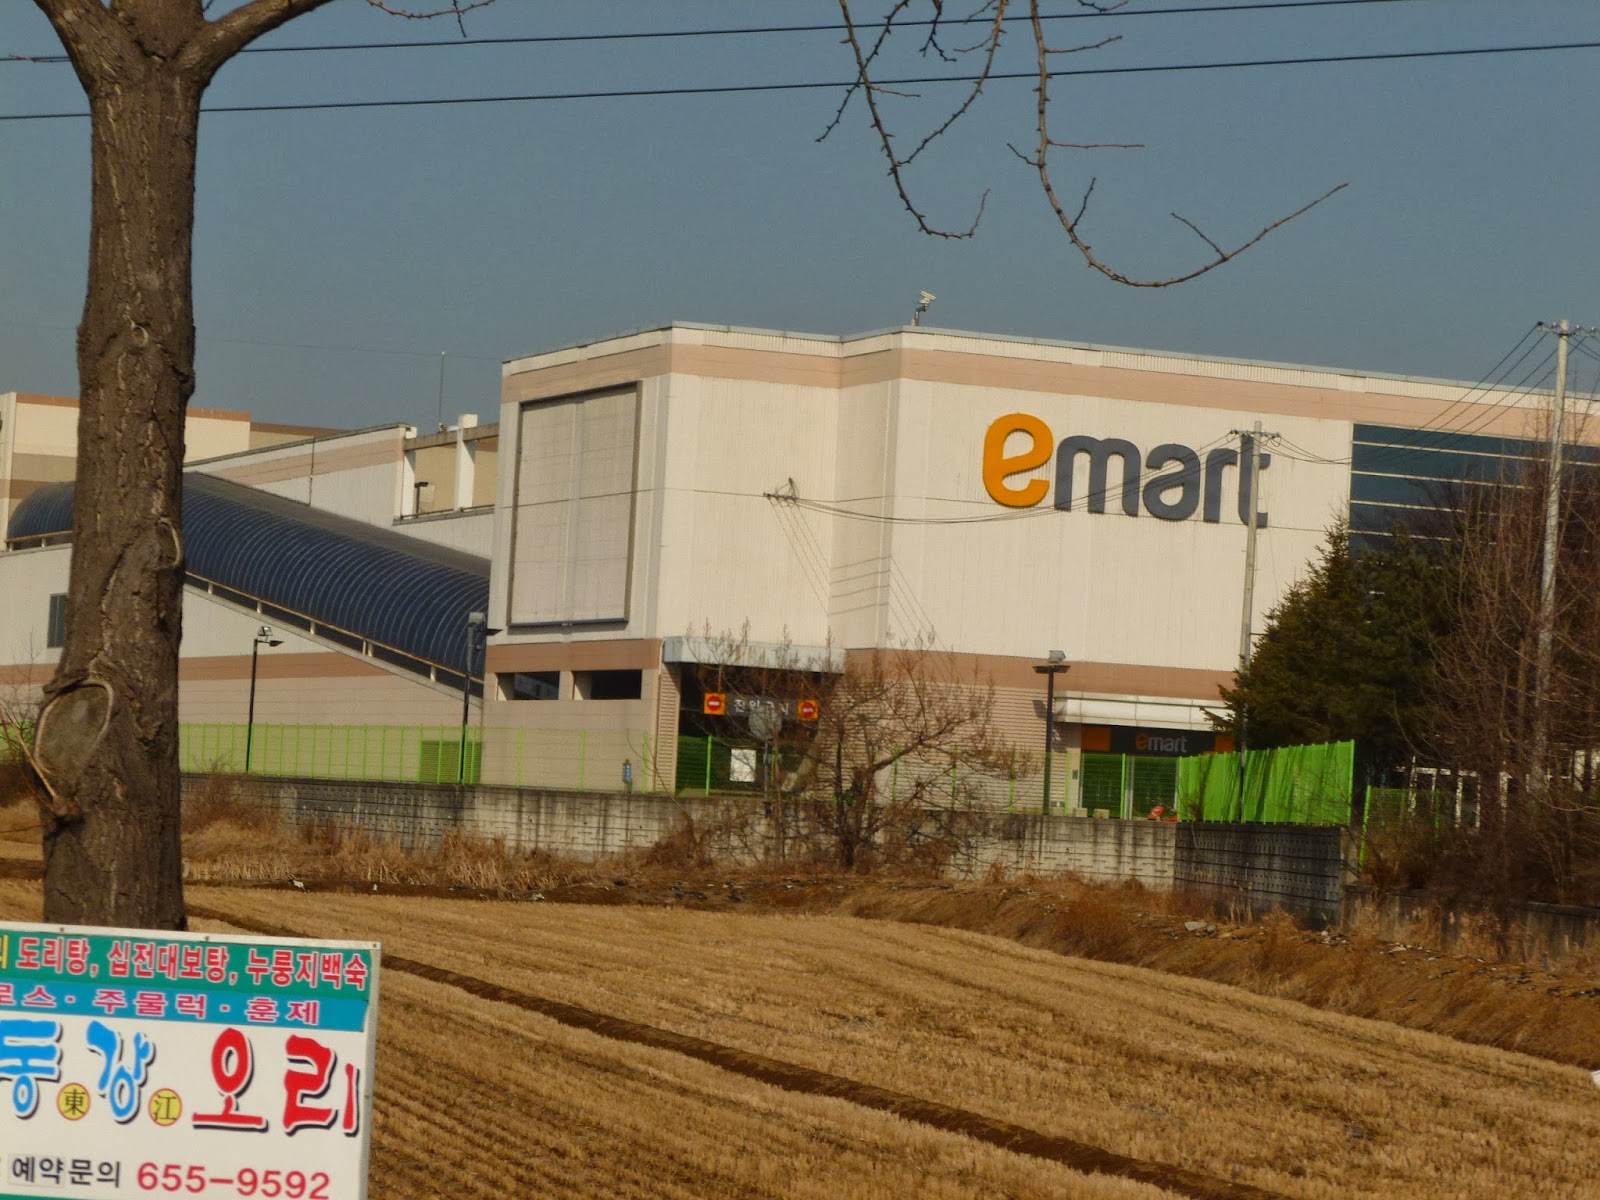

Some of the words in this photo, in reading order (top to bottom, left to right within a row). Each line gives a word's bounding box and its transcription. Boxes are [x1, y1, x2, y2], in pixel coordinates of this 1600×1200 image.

[982, 412, 1271, 528] emart
[1135, 732, 1188, 753] emart
[17, 936, 98, 977] 도리탕,
[107, 940, 238, 984] 십전대보탕,
[246, 949, 367, 991] 누룽지백숙
[93, 989, 207, 1020] 주물럭
[244, 997, 319, 1025] 훈제
[191, 1027, 361, 1138] 오리
[12, 1156, 120, 1188] 예약문의
[137, 1162, 330, 1200] 655-9592
